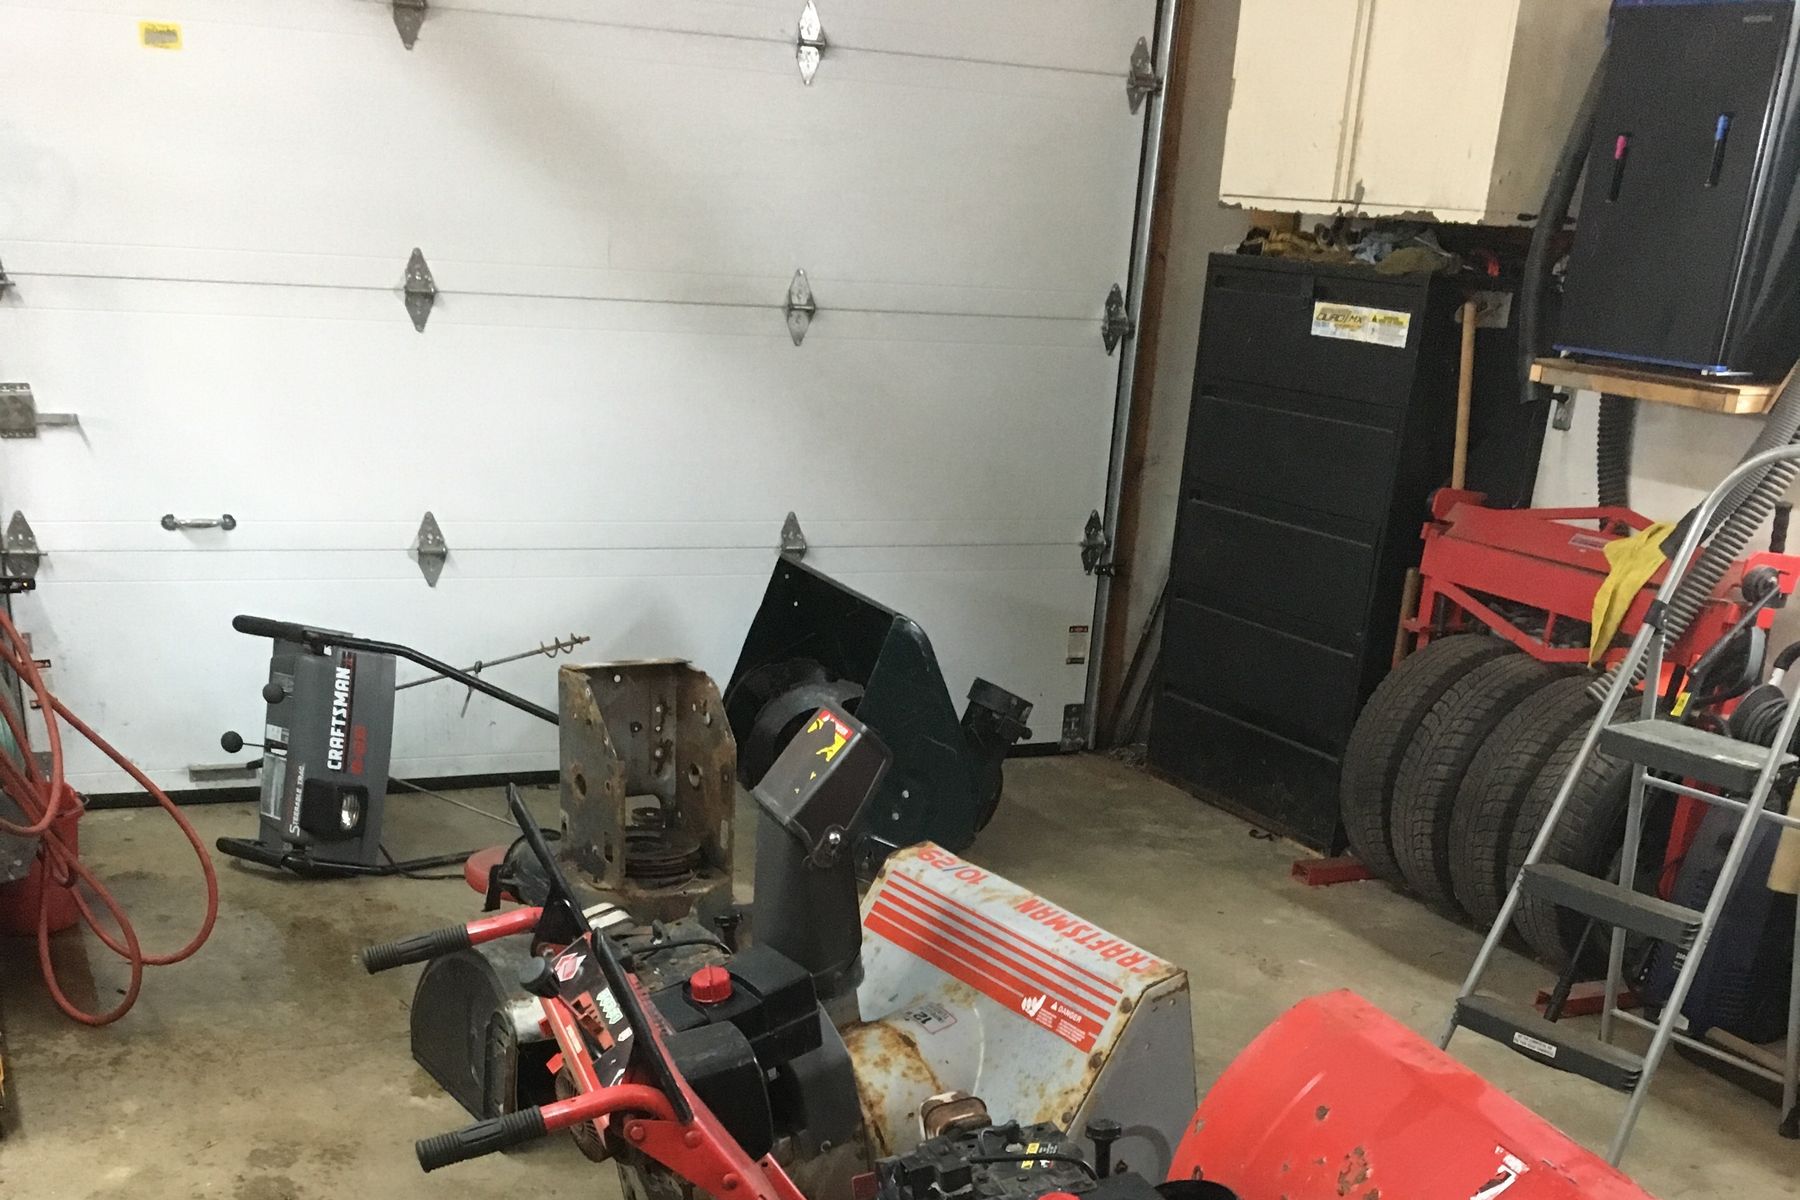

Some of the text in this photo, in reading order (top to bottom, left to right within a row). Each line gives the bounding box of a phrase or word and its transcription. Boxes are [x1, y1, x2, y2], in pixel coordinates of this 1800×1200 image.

[327, 666, 351, 771] CRAFTSMAN
[289, 787, 303, 836] STEERABLE
[916, 848, 990, 885] 10/29
[1014, 898, 1159, 974] CRAFTSMAN
[1058, 1005, 1083, 1024] DANGER
